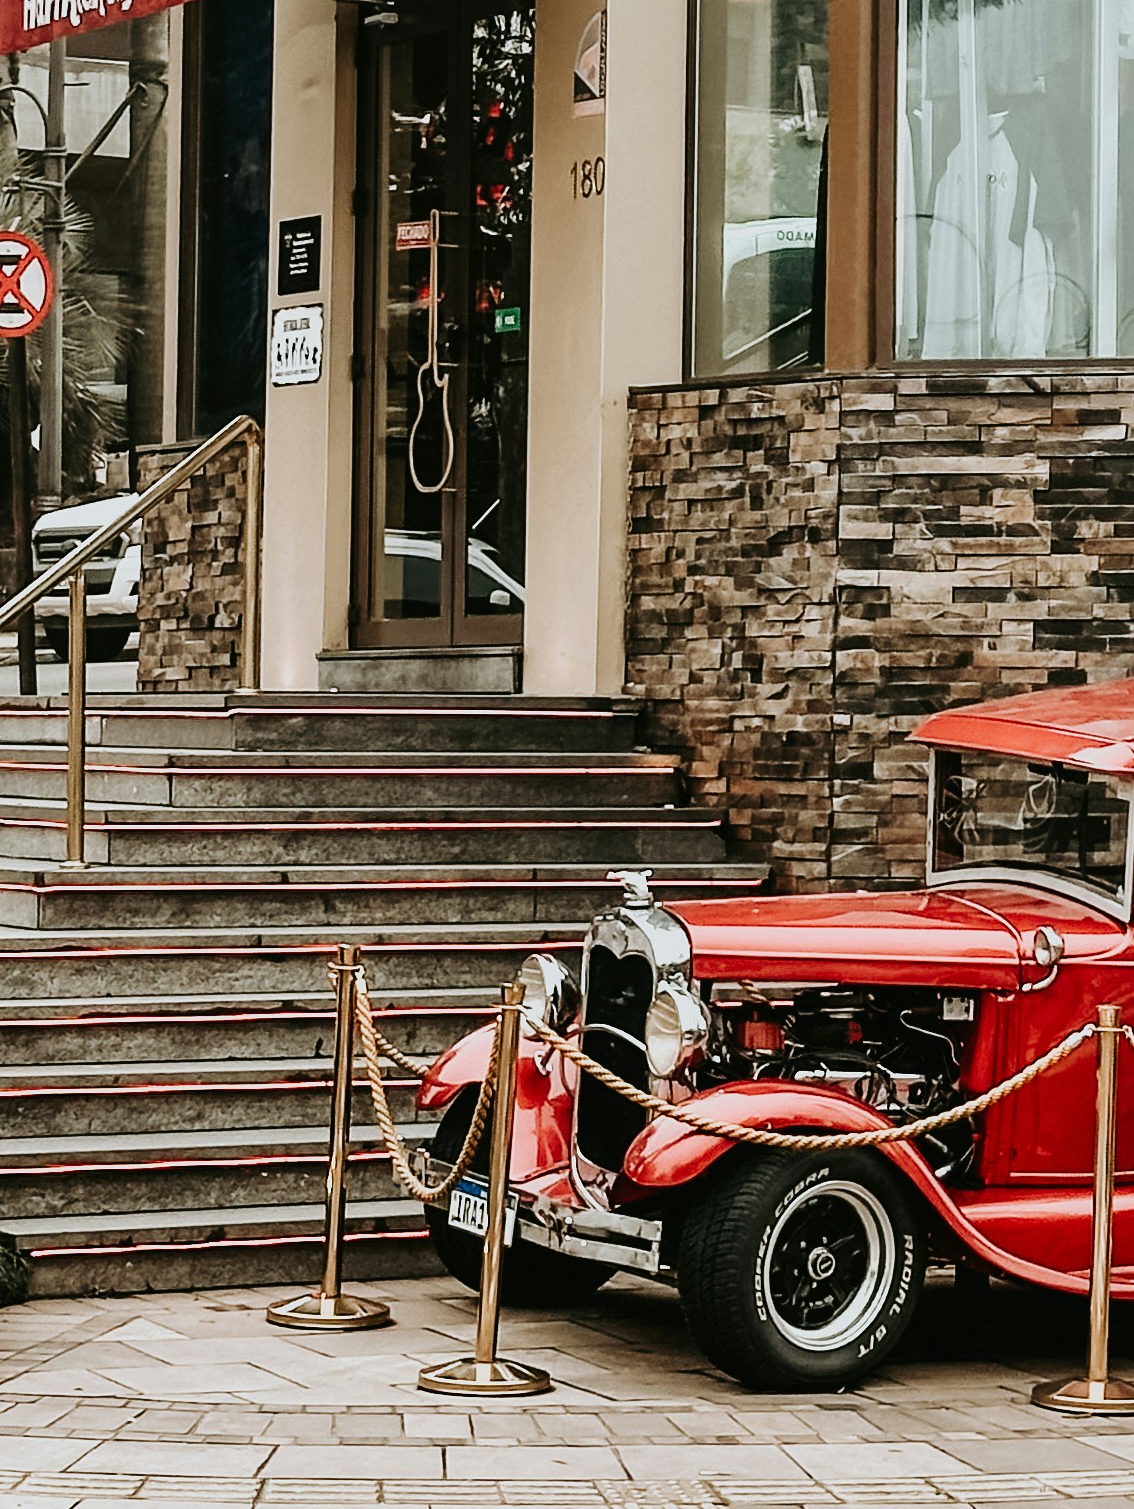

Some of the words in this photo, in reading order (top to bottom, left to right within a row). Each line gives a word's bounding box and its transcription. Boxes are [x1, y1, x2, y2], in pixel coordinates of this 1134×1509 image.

[570, 156, 605, 199] 180
[754, 1225, 771, 1321] COOPER
[775, 1167, 830, 1217] COBRA
[890, 1234, 915, 1317] RADIAL
